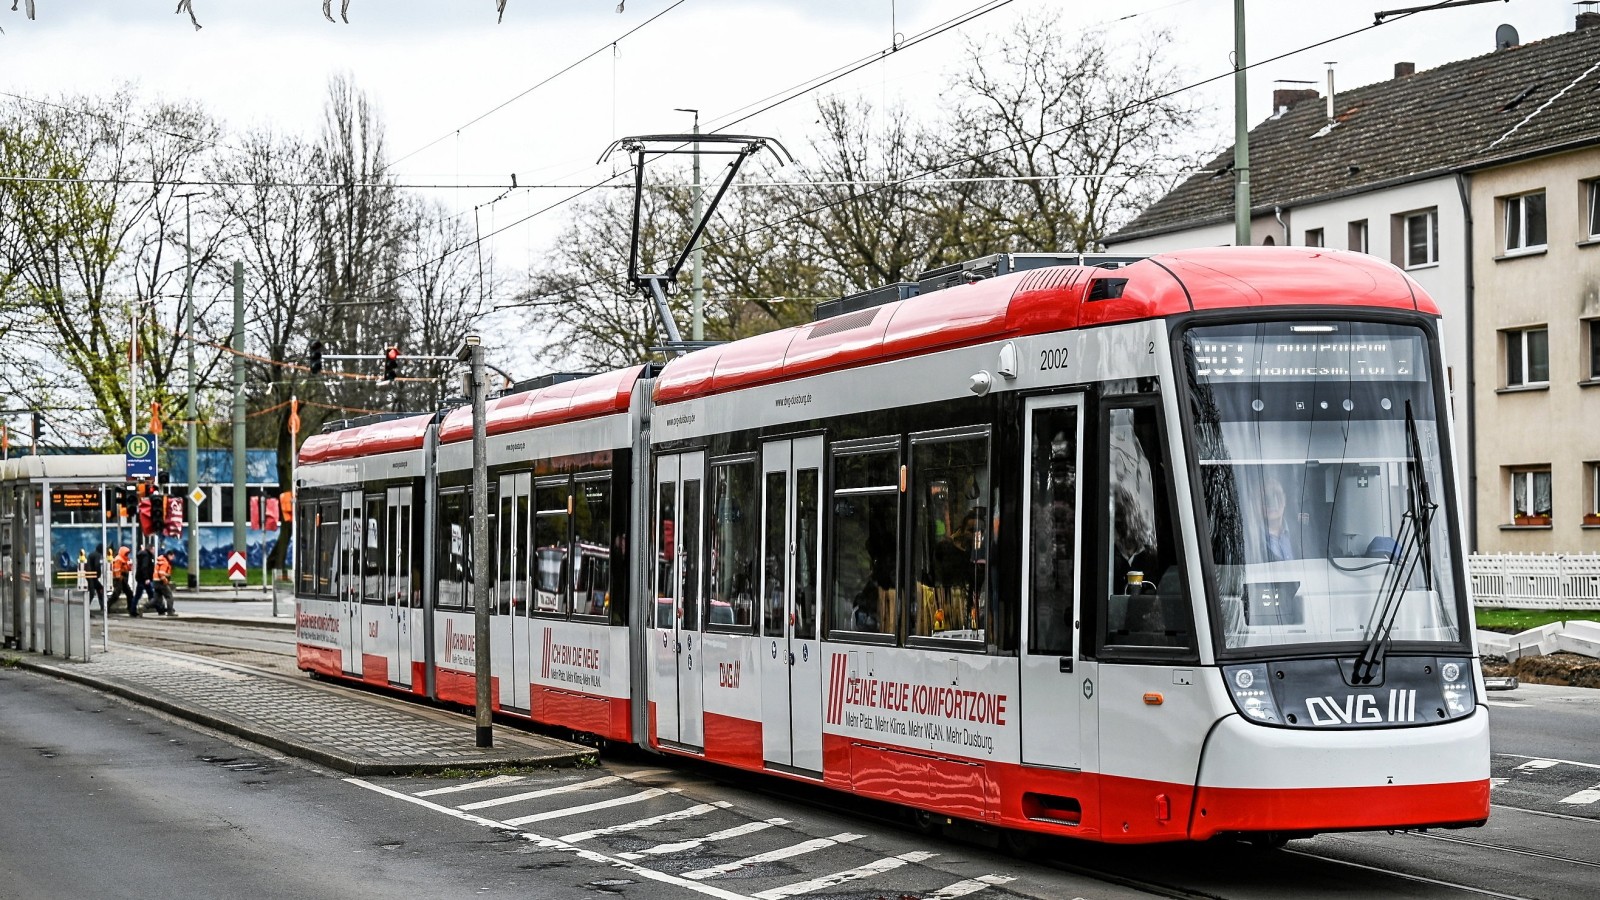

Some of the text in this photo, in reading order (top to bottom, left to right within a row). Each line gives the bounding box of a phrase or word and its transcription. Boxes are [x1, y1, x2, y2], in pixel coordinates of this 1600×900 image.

[1040, 347, 1068, 371] 2002
[1148, 341, 1155, 354] 2
[151, 440, 155, 449] 1
[551, 643, 599, 670] ICH BIN DIE NEUE
[845, 677, 1007, 726] DEINE NEUE KOMFORTZONE
[845, 711, 994, 754] Mehr Platz. Mehr Klima. Mehr WLAN. Mehr Duisburg.
